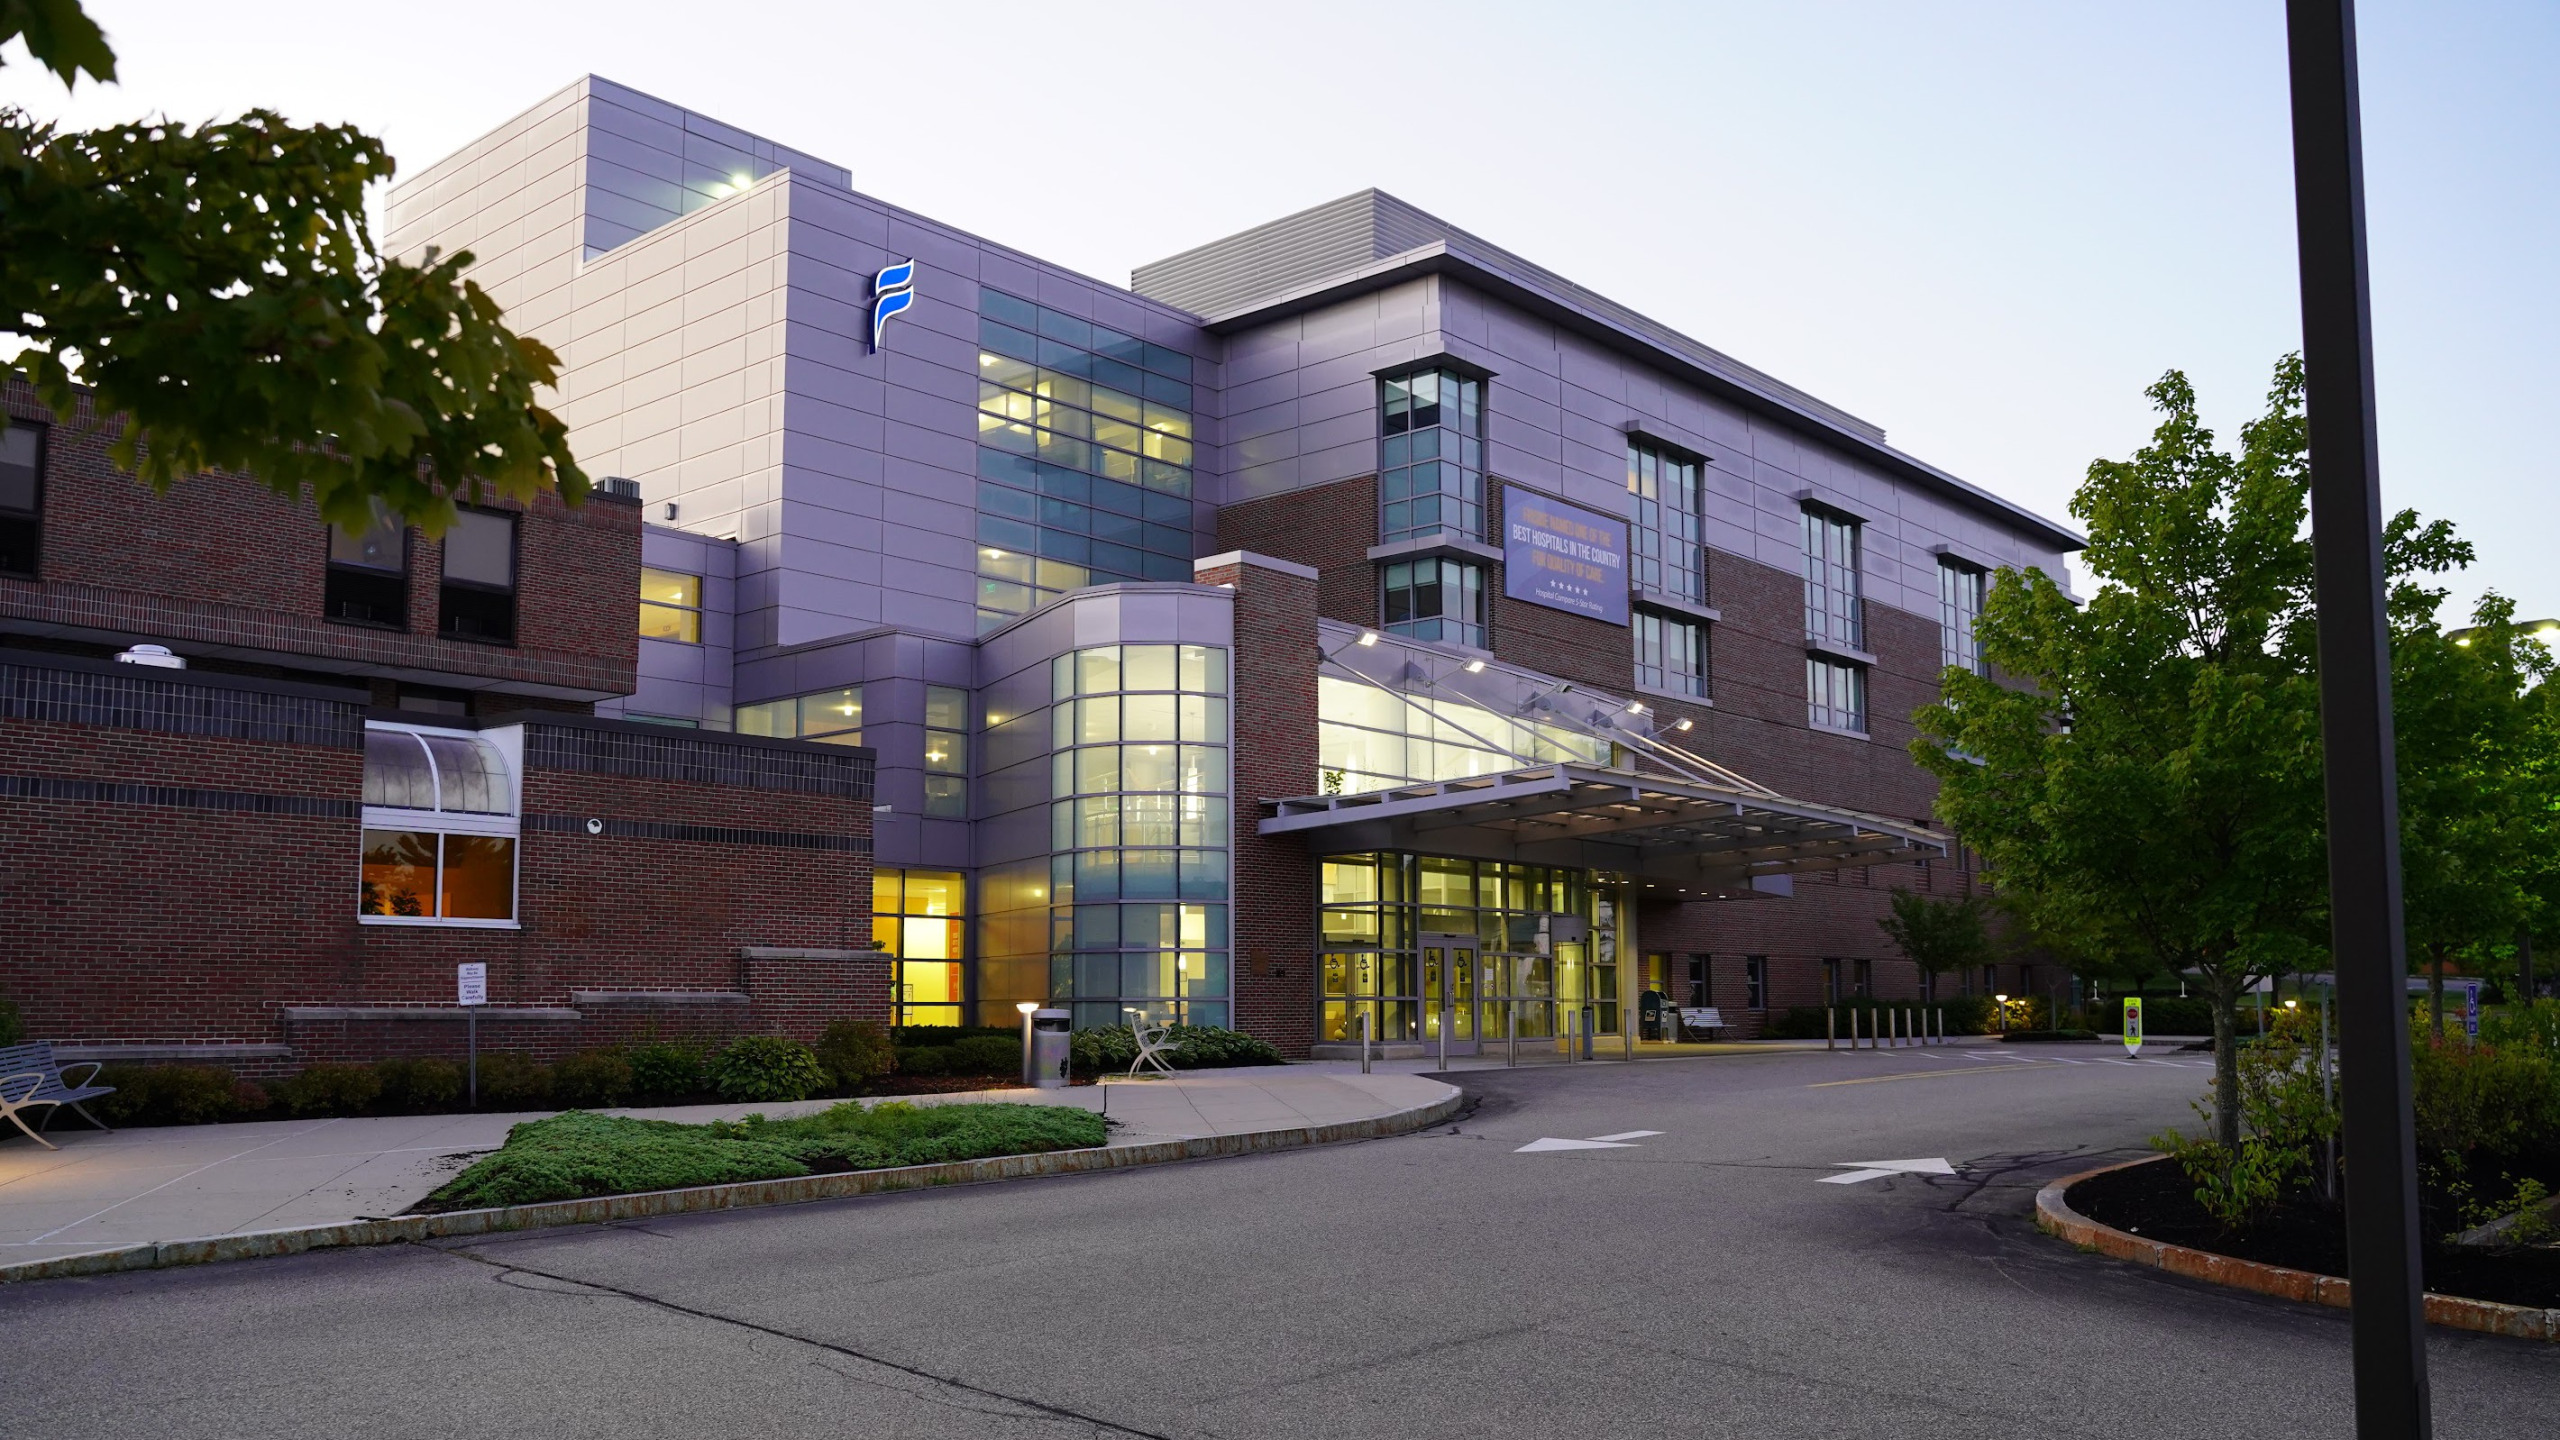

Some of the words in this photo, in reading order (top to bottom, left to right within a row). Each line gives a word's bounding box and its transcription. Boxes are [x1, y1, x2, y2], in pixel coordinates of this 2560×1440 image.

[1513, 524, 1531, 543] BEST
[1532, 530, 1569, 554] HOSPITALS
[1570, 541, 1577, 556] IN
[1578, 543, 1590, 560] THE
[1592, 548, 1620, 568] COUNTRY
[1536, 588, 1554, 599] Hospital
[1554, 593, 1575, 604] Compare
[1589, 601, 1603, 614] Rating
